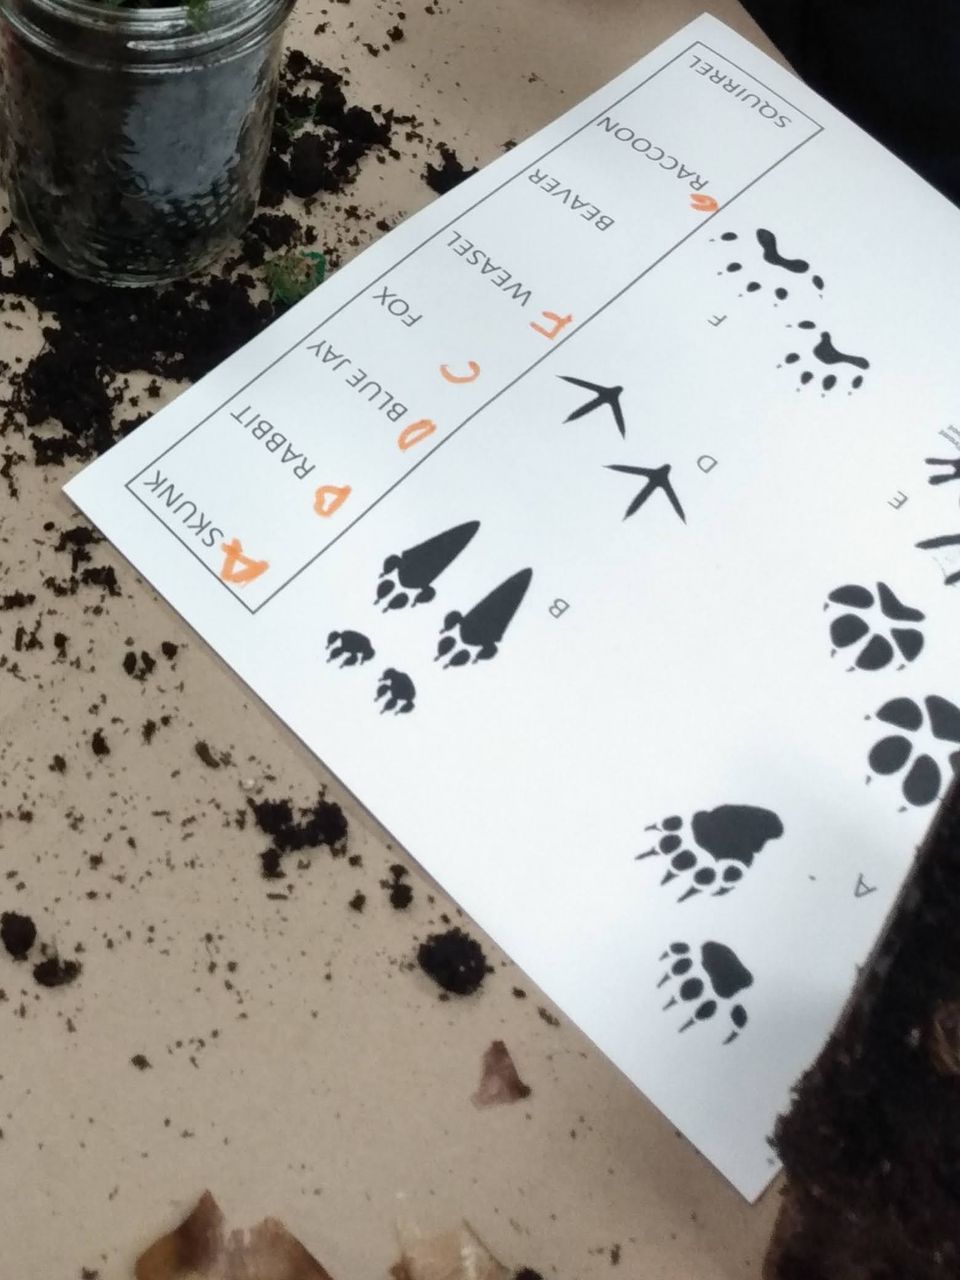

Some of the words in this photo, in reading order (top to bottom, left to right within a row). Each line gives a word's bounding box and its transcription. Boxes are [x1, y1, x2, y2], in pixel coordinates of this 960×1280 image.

[688, 54, 793, 129] SQUIRREL
[596, 116, 710, 192] RACCOON
[527, 168, 616, 232] BEAVER
[446, 230, 533, 308] WEASEL
[371, 285, 424, 328] FOX
[531, 310, 575, 341] F
[707, 315, 728, 328] F
[305, 339, 352, 373] JAY
[439, 360, 481, 385] C
[346, 367, 409, 423] BLUE
[229, 405, 317, 481] RABBIT
[696, 454, 718, 474] D
[142, 469, 225, 548] SKUNK
[887, 490, 909, 510] E
[218, 536, 271, 587] A
[548, 598, 570, 619] B
[854, 873, 877, 898] A
